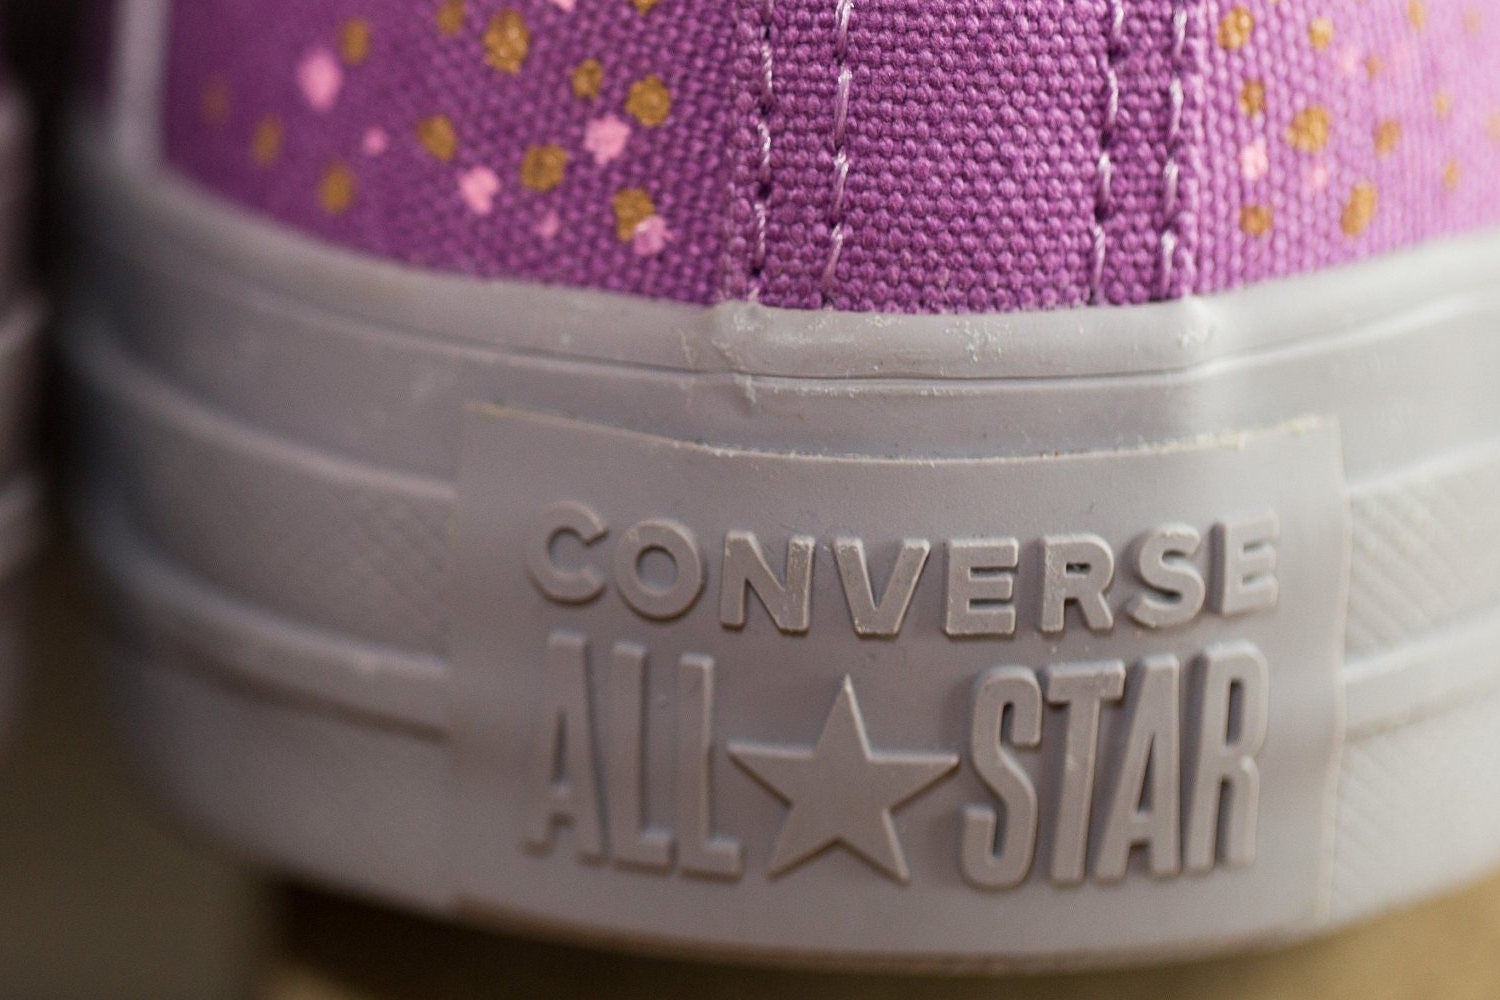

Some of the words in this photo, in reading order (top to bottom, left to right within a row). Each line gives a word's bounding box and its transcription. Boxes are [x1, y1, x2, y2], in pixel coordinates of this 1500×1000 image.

[525, 500, 1281, 637] CONVERSE
[521, 630, 743, 879] ALL
[961, 638, 1270, 892] STAR
